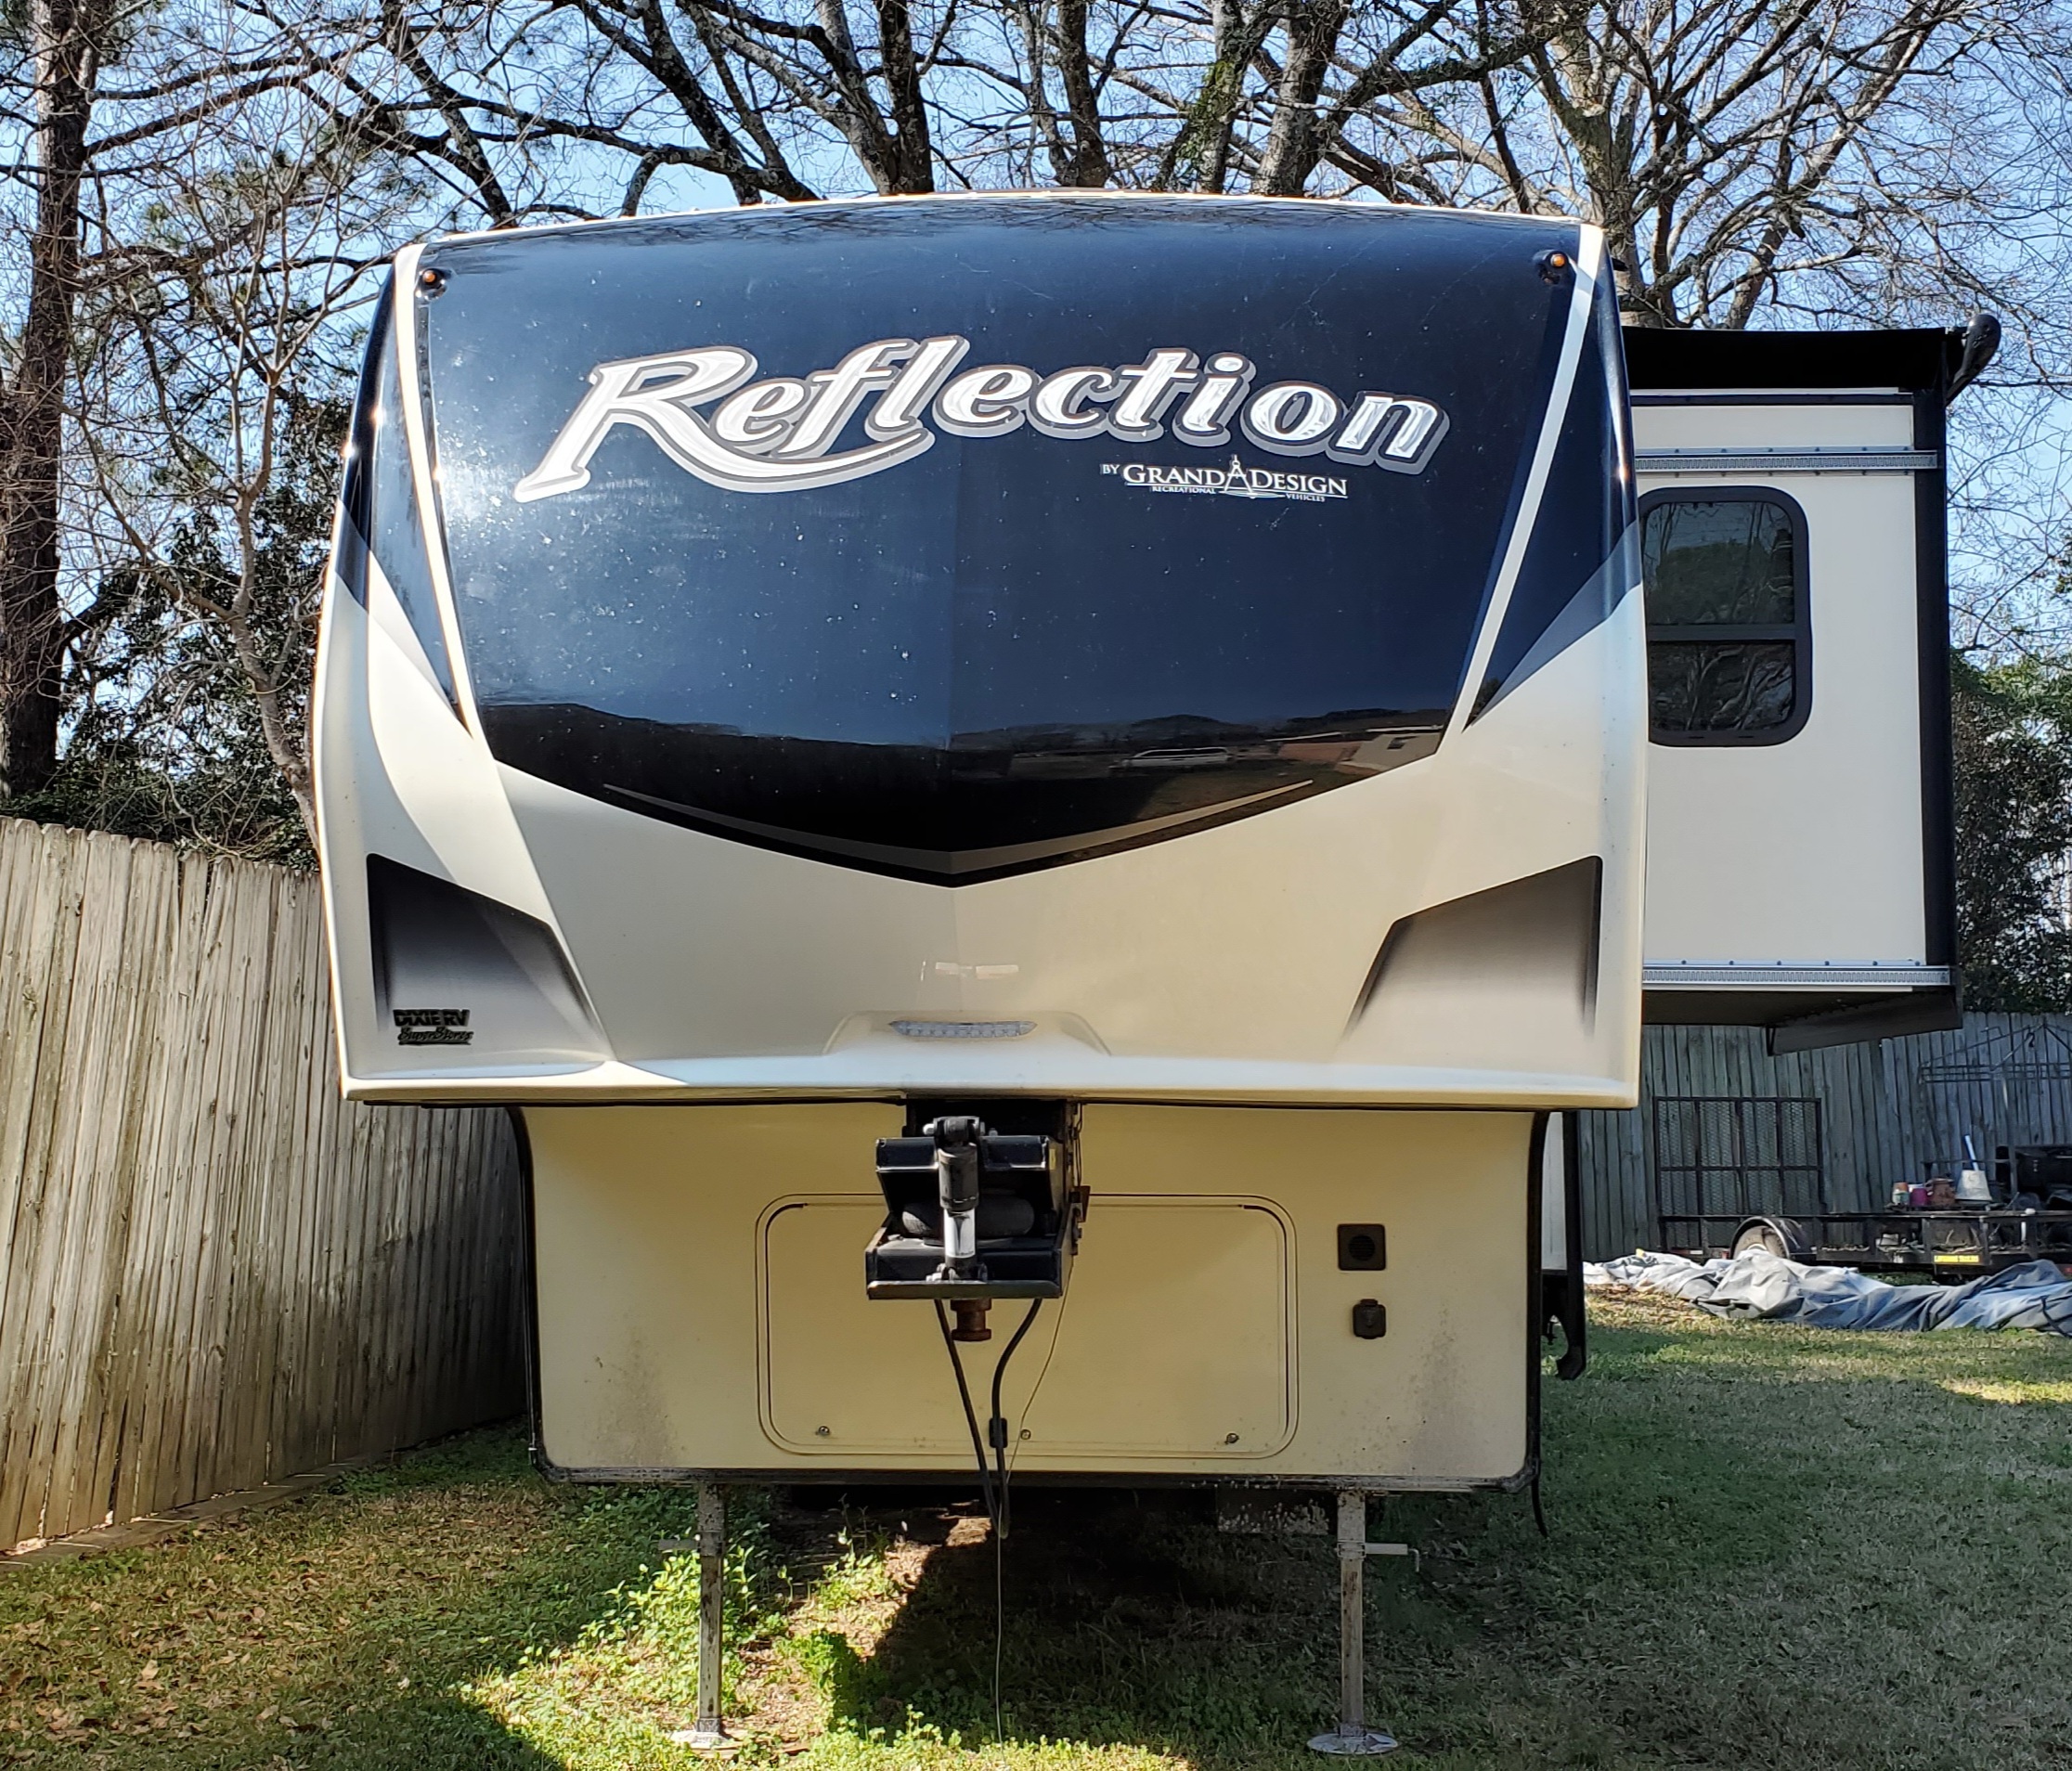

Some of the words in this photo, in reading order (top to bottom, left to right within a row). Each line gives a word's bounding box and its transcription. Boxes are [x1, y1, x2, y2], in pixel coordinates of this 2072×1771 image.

[514, 335, 1450, 502] Reflection
[1101, 464, 1120, 475] BY
[1123, 463, 1225, 486] GRAND
[1250, 469, 1348, 496] DESIGN
[1152, 485, 1217, 495] RECREATIONAL
[1286, 493, 1327, 503] VEHICLES
[443, 1009, 471, 1027] RV
